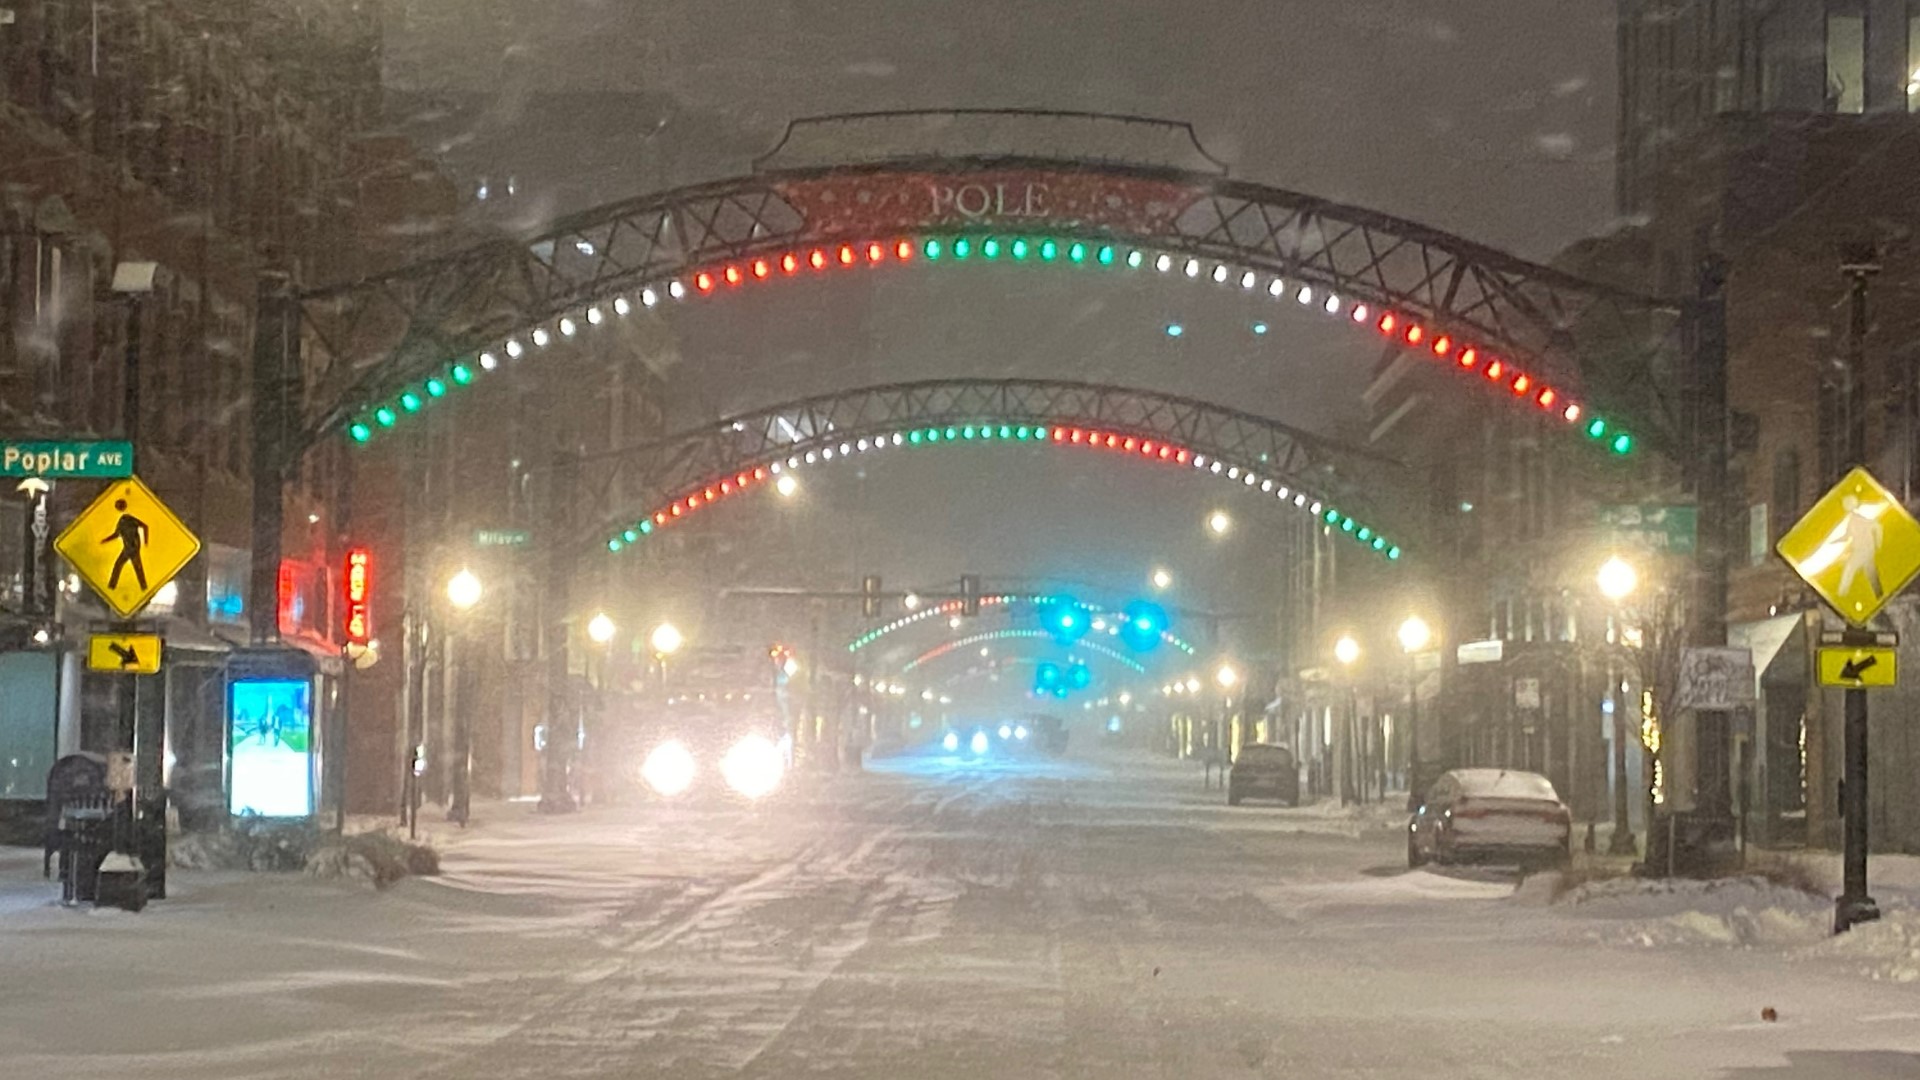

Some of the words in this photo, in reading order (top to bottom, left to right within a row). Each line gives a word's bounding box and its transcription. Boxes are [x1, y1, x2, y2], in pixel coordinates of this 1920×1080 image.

[930, 184, 1049, 216] POLE
[4, 446, 89, 474] Poplar
[97, 452, 122, 466] AVE
